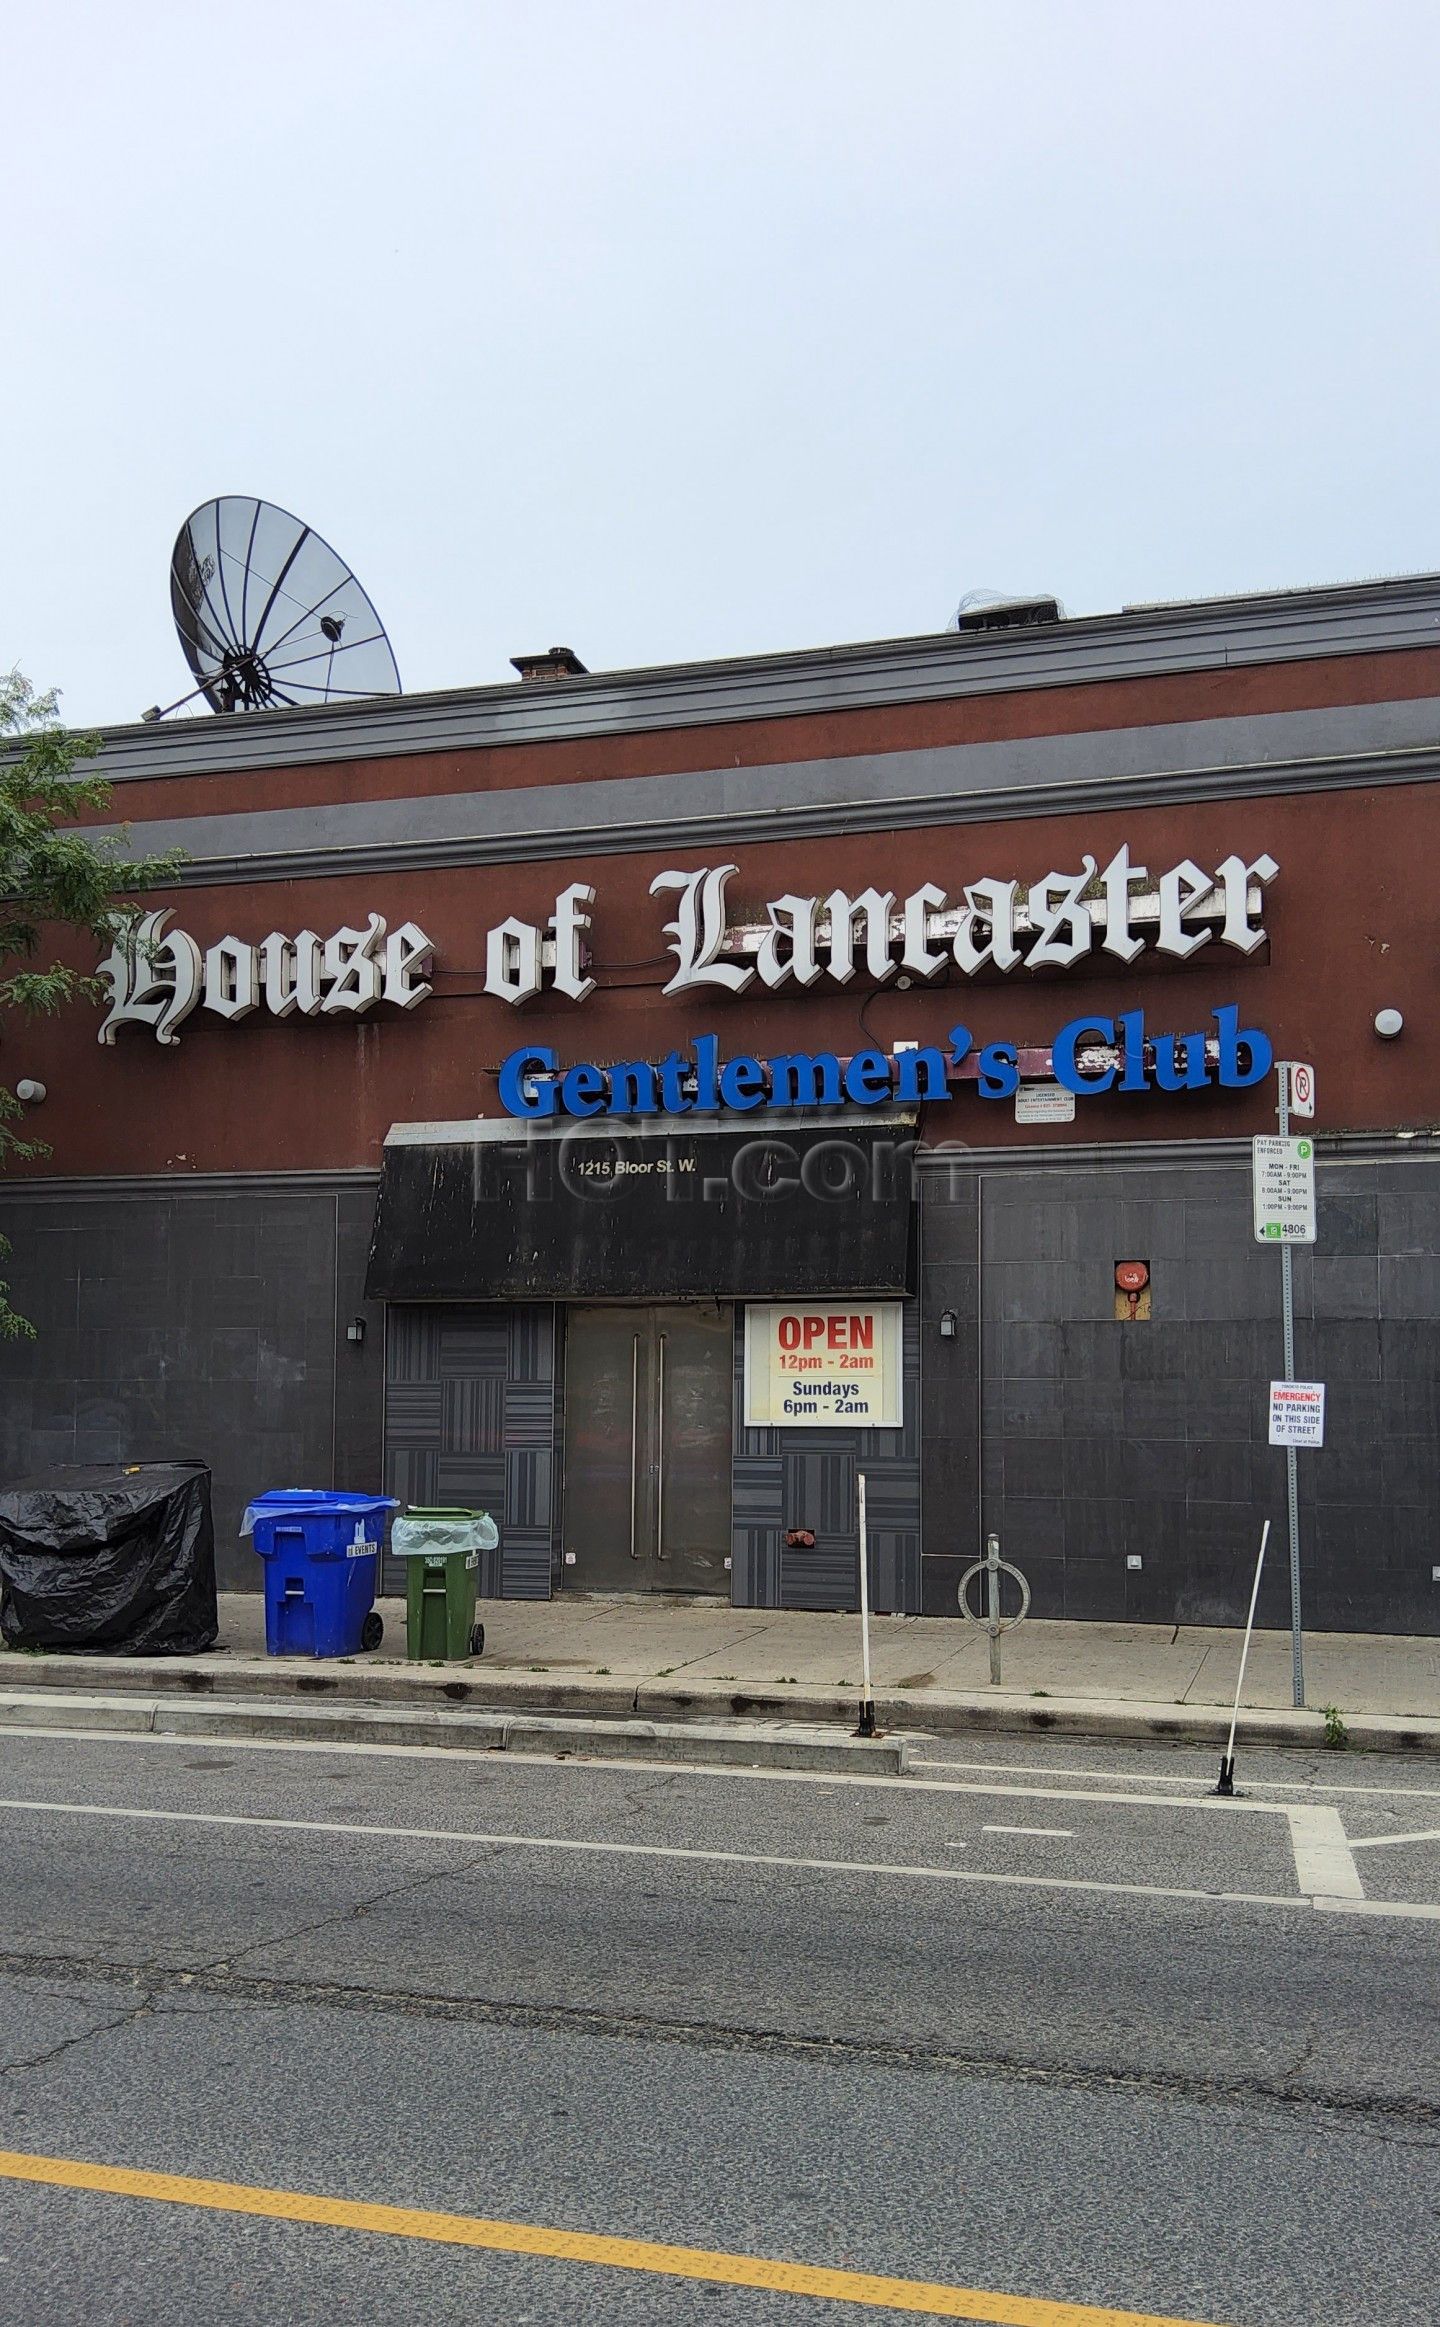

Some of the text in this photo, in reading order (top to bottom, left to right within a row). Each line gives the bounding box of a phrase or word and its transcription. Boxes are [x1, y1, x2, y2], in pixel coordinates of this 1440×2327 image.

[95, 842, 1280, 1046] House of Lancaster
[498, 1002, 1273, 1119] Gentlemen's Club
[578, 1159, 697, 1176] 1215 Bloor St. W.
[1282, 1224, 1306, 1234] 4806
[778, 1315, 873, 1351] OPEN
[779, 1354, 822, 1372] 12pm
[839, 1354, 874, 1369] 2am
[793, 1381, 860, 1398] Sundays
[1273, 1392, 1320, 1401] EMERGENCY
[783, 1399, 817, 1416] 6pm
[834, 1399, 869, 1413] 2am
[1273, 1403, 1320, 1413] NO PARKING
[1272, 1414, 1320, 1424] ON THIS SIDE
[1276, 1425, 1316, 1434] OF STREET
[355, 1543, 375, 1555] EVENTS
